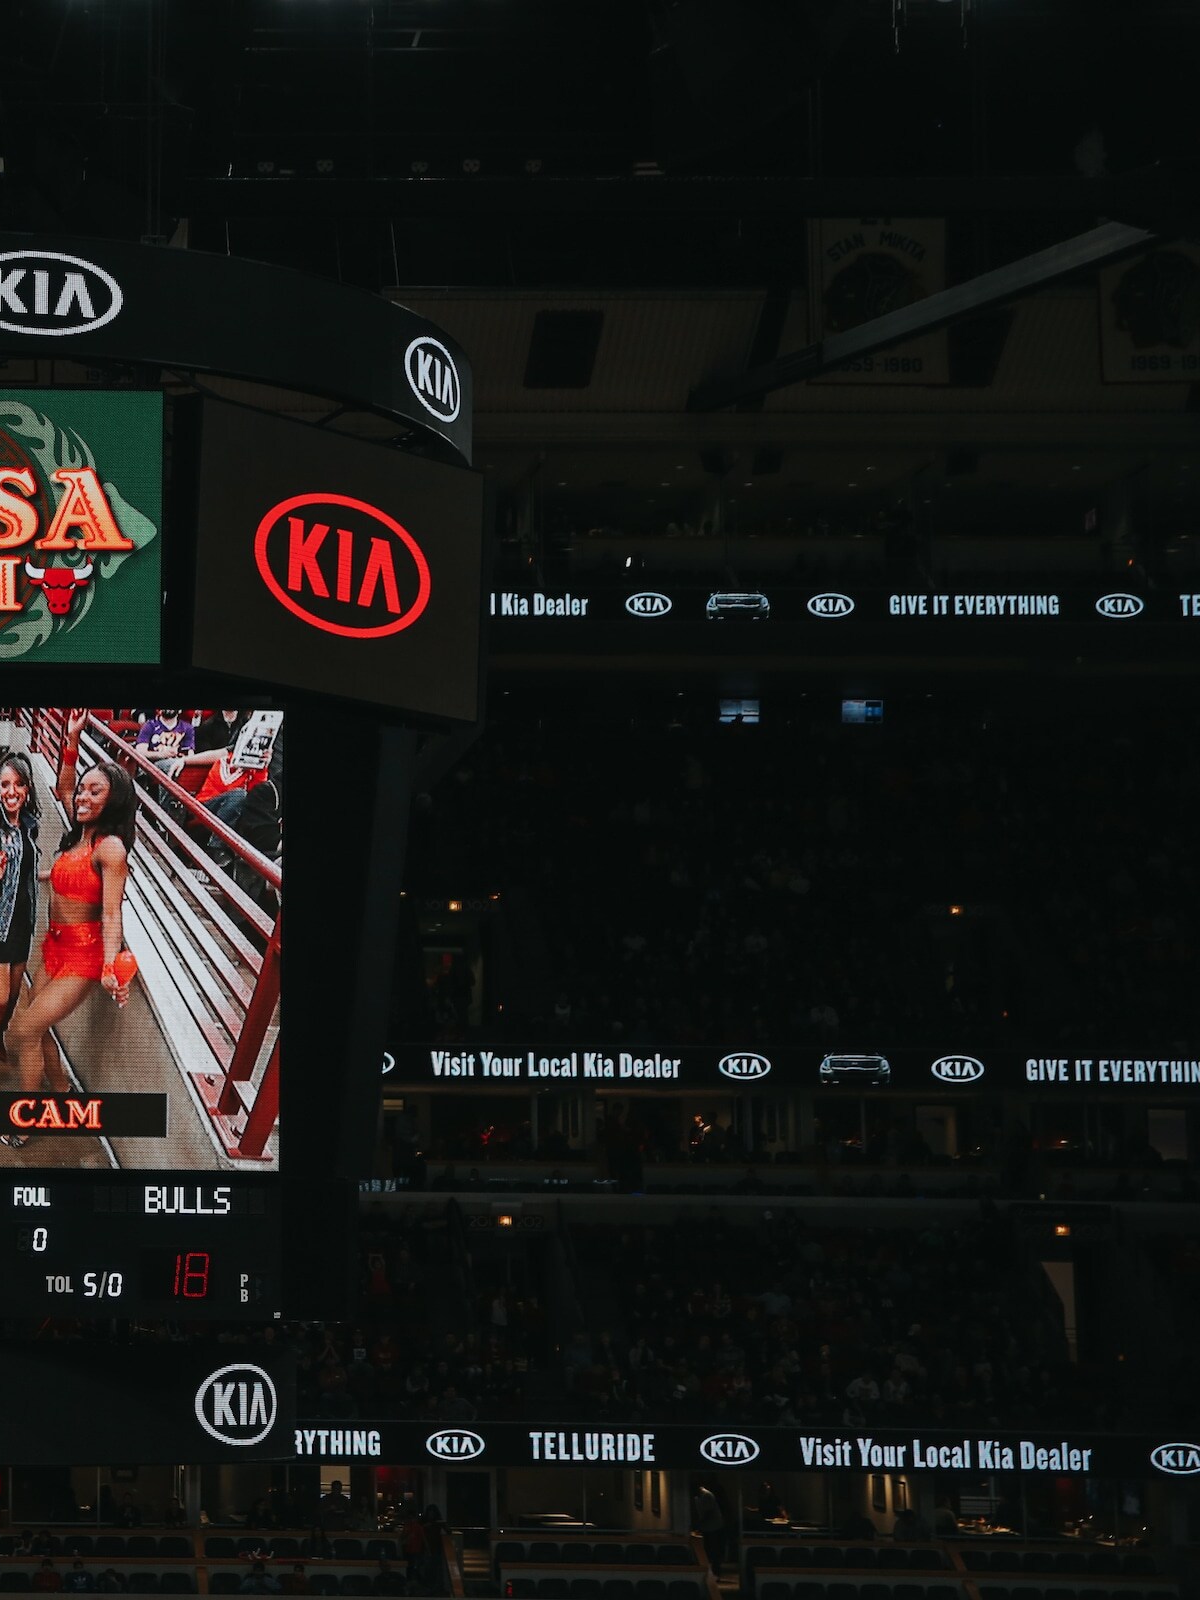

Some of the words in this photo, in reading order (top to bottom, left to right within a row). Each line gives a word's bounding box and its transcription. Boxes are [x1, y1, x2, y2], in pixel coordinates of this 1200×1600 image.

[827, 232, 866, 262] STAN
[879, 231, 927, 262] MIKITA
[417, 349, 454, 410] KIA
[288, 517, 400, 613] KIA
[501, 592, 529, 616] Kia
[533, 592, 589, 616] Dealer
[633, 597, 665, 612] KIA
[815, 598, 847, 612] KIA
[889, 594, 927, 615] GIVE
[933, 595, 949, 615] IT
[954, 594, 1060, 615] EVERYTHING
[1104, 599, 1136, 612] KIA
[430, 1050, 475, 1077] Visit
[480, 1051, 523, 1077] Your
[527, 1051, 578, 1078] Local
[583, 1052, 615, 1078] Kia
[619, 1052, 681, 1079] Dealer
[728, 1059, 762, 1073] KIA
[940, 1062, 975, 1076] KIA
[1025, 1058, 1069, 1082] GIVE
[1075, 1059, 1093, 1082] IT
[1098, 1060, 1200, 1083] EVERYTHIN
[9, 1098, 102, 1129] CAM
[13, 1186, 51, 1207] FOUL
[144, 1185, 231, 1215] BULLS
[32, 1227, 48, 1252] 0
[45, 1275, 74, 1293] TOL
[83, 1271, 123, 1298] 5/0
[174, 1252, 210, 1297] 18
[213, 1383, 267, 1425] KIA
[294, 1429, 381, 1456] RYTHING
[436, 1436, 475, 1453] KIA
[529, 1431, 656, 1462] TELLURIDE
[711, 1441, 750, 1458] KIA
[799, 1437, 852, 1467] Visit
[856, 1437, 907, 1468] Your
[912, 1439, 971, 1469] Local
[977, 1440, 1015, 1470] Kia
[1019, 1441, 1092, 1471] Dealer
